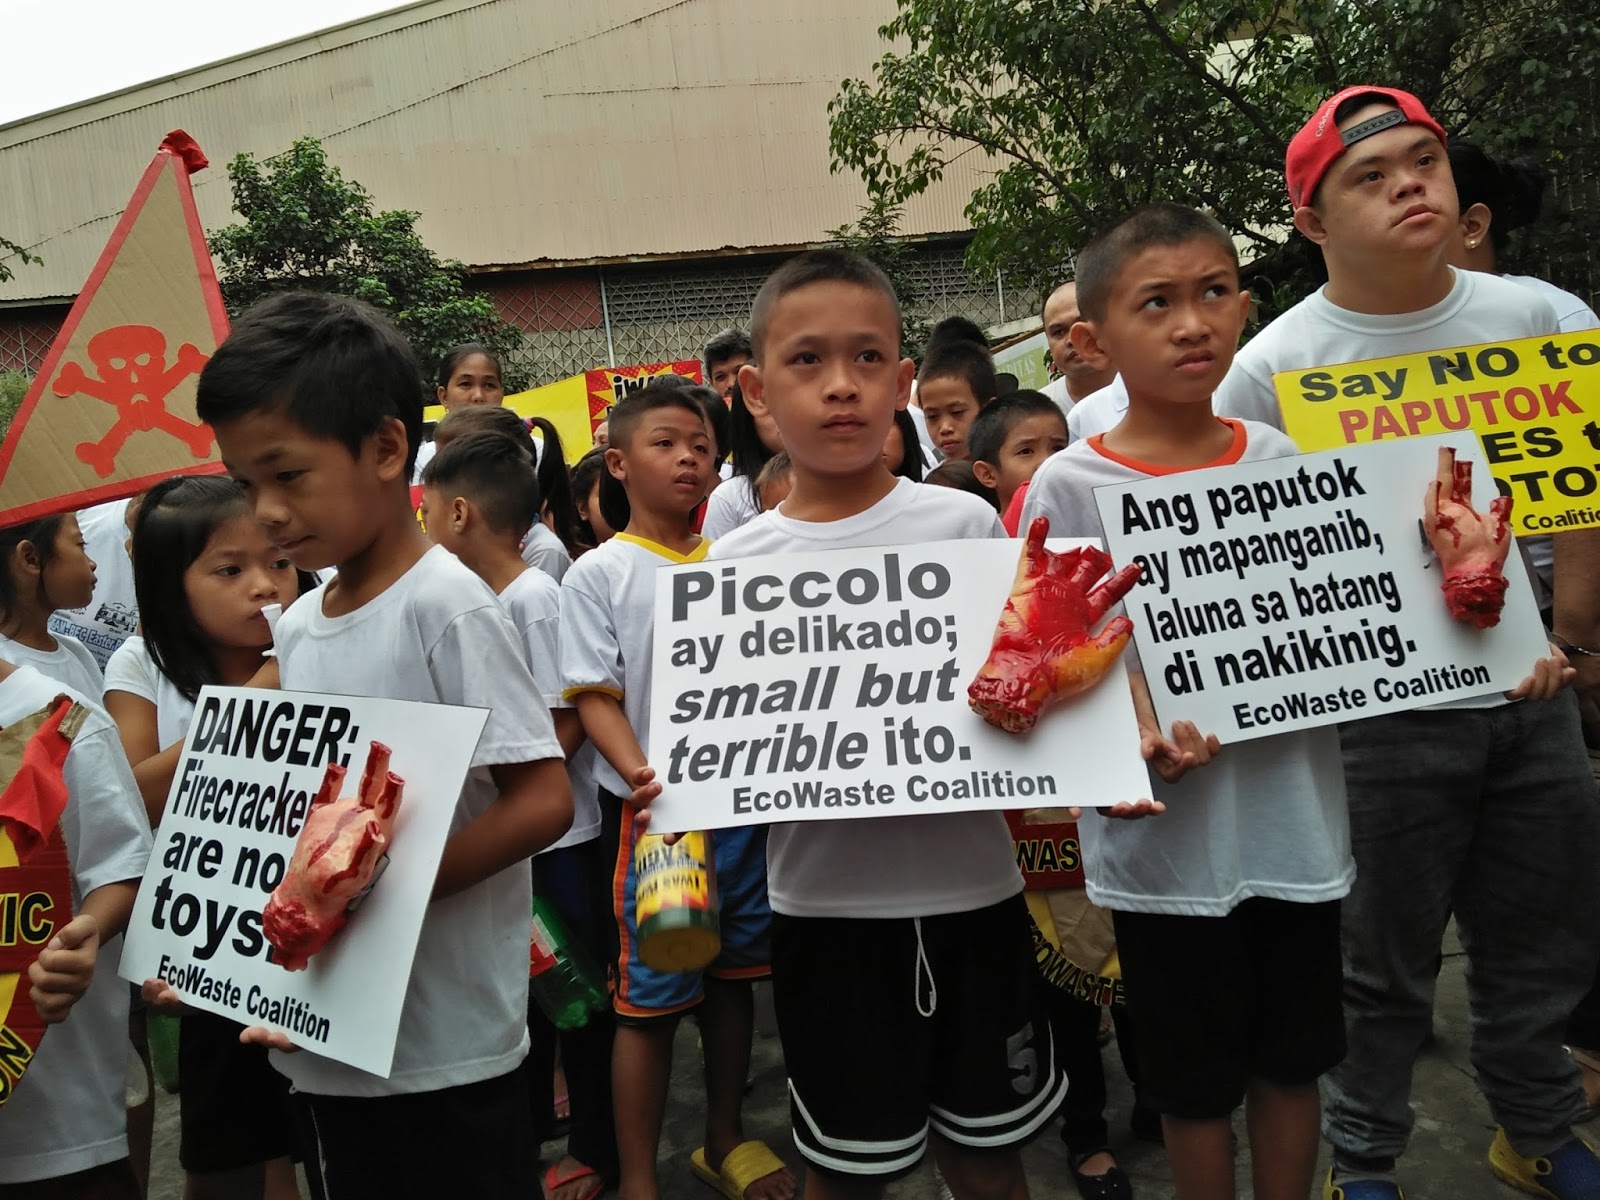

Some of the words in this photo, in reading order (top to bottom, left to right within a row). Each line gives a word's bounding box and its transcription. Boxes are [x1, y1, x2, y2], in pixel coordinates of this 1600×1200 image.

[1300, 368, 1407, 402] Say
[1428, 347, 1520, 386] NO
[1540, 341, 1600, 370] to
[1338, 380, 1584, 444] PAPUTOK
[1481, 427, 1563, 464] ES
[1121, 492, 1198, 536] Ang
[1206, 458, 1367, 529] paputok
[1493, 463, 1600, 502] TO
[1135, 549, 1170, 594] ay
[1180, 509, 1384, 579] mapanganib,
[672, 554, 951, 622] Piccolo
[1144, 597, 1246, 643] laluna
[1252, 590, 1289, 626] sa
[1290, 571, 1402, 618] batang
[671, 635, 723, 674] ay
[740, 609, 957, 658] delikado;
[1164, 650, 1204, 696] di
[1214, 622, 1418, 688] nakikinig.
[669, 666, 840, 724] small
[856, 657, 960, 708] but
[1233, 686, 1367, 730] EcoWaste
[1374, 664, 1491, 702] Coalition
[191, 697, 359, 768] DANGER:
[667, 722, 868, 784] terrible
[885, 717, 972, 766] ito.
[733, 778, 895, 815] EcoWaste
[907, 771, 1057, 801] Coalition
[163, 831, 223, 878] are
[232, 846, 293, 893] no
[0, 892, 54, 946] IC
[157, 954, 241, 1009] EcoWaste
[247, 985, 330, 1042] Coalition
[1006, 1021, 1037, 1094] 5
